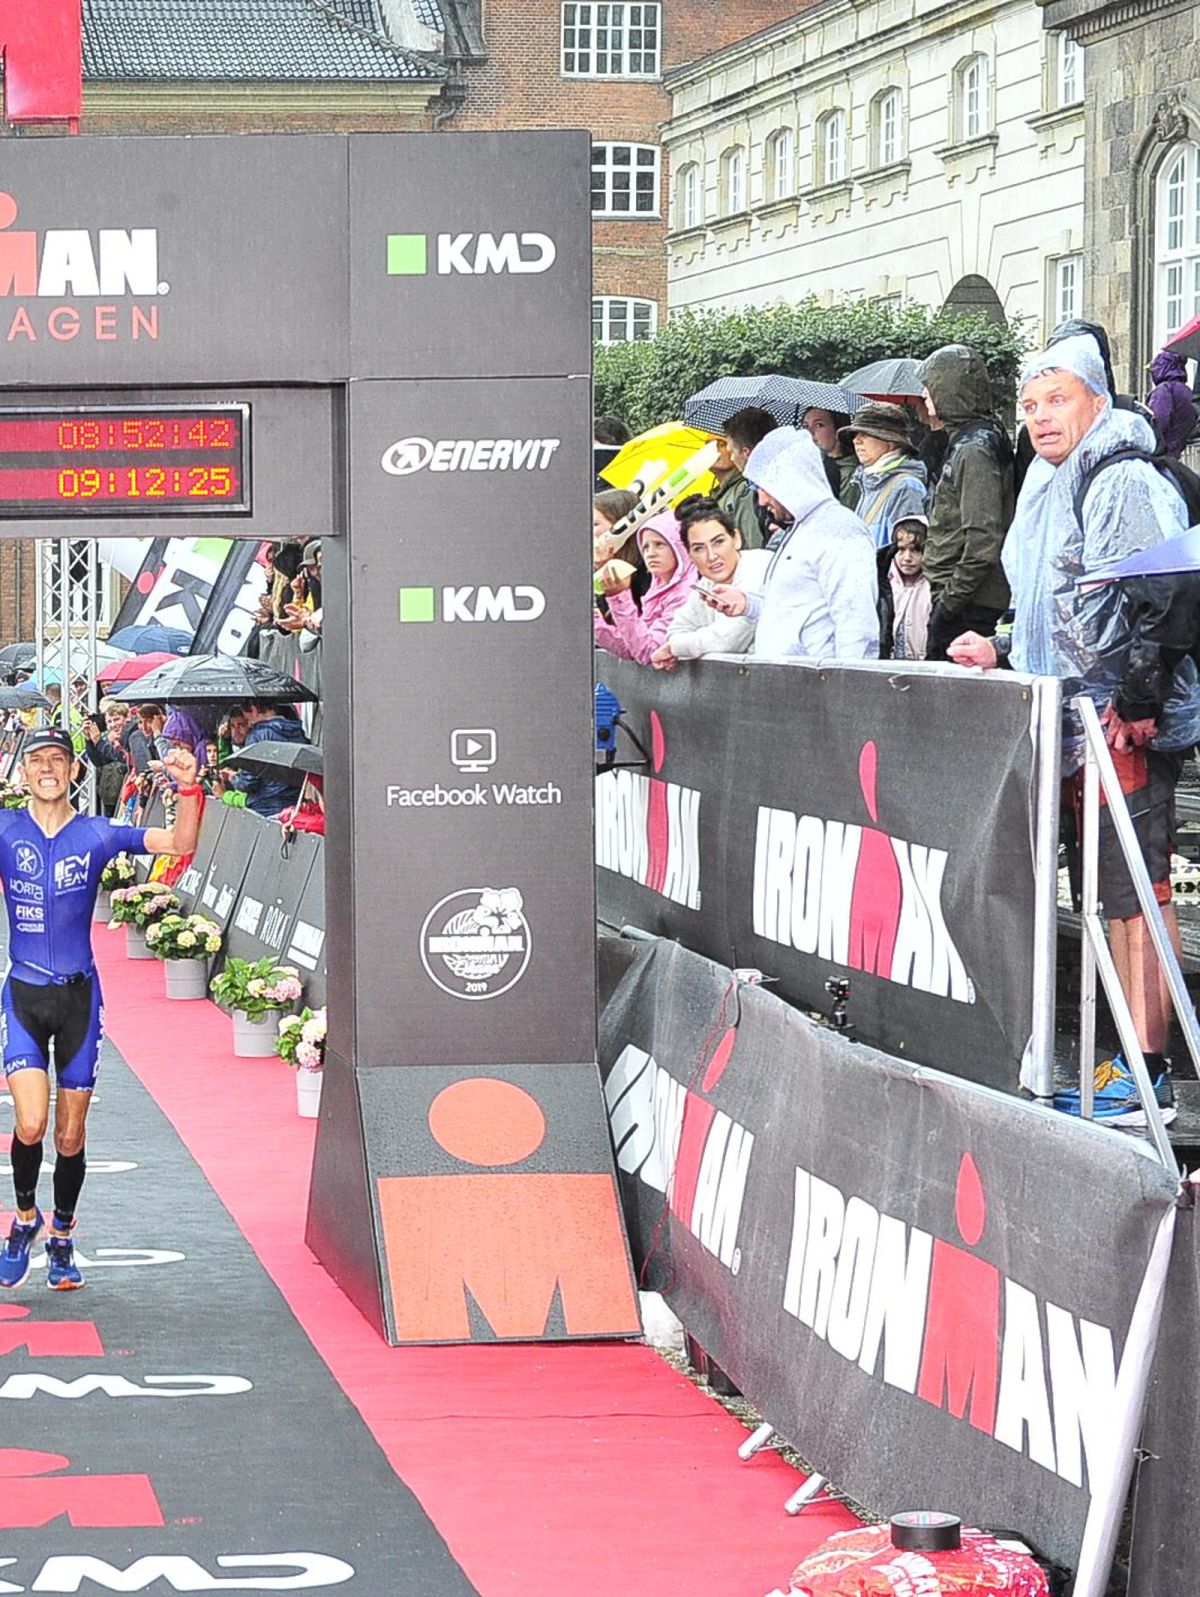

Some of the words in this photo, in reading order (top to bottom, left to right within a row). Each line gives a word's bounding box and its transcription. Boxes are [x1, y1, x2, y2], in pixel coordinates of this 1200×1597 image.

[437, 232, 556, 275] KMD
[57, 420, 232, 449] 08:52:42
[428, 438, 560, 471] ENERVIT
[57, 469, 232, 499] 09:12:25
[443, 585, 546, 622] KMD
[386, 784, 487, 806] Facebook
[492, 782, 562, 805] Watch
[753, 806, 973, 1004] IRONMAN
[784, 1166, 1130, 1497] IRONMAN
